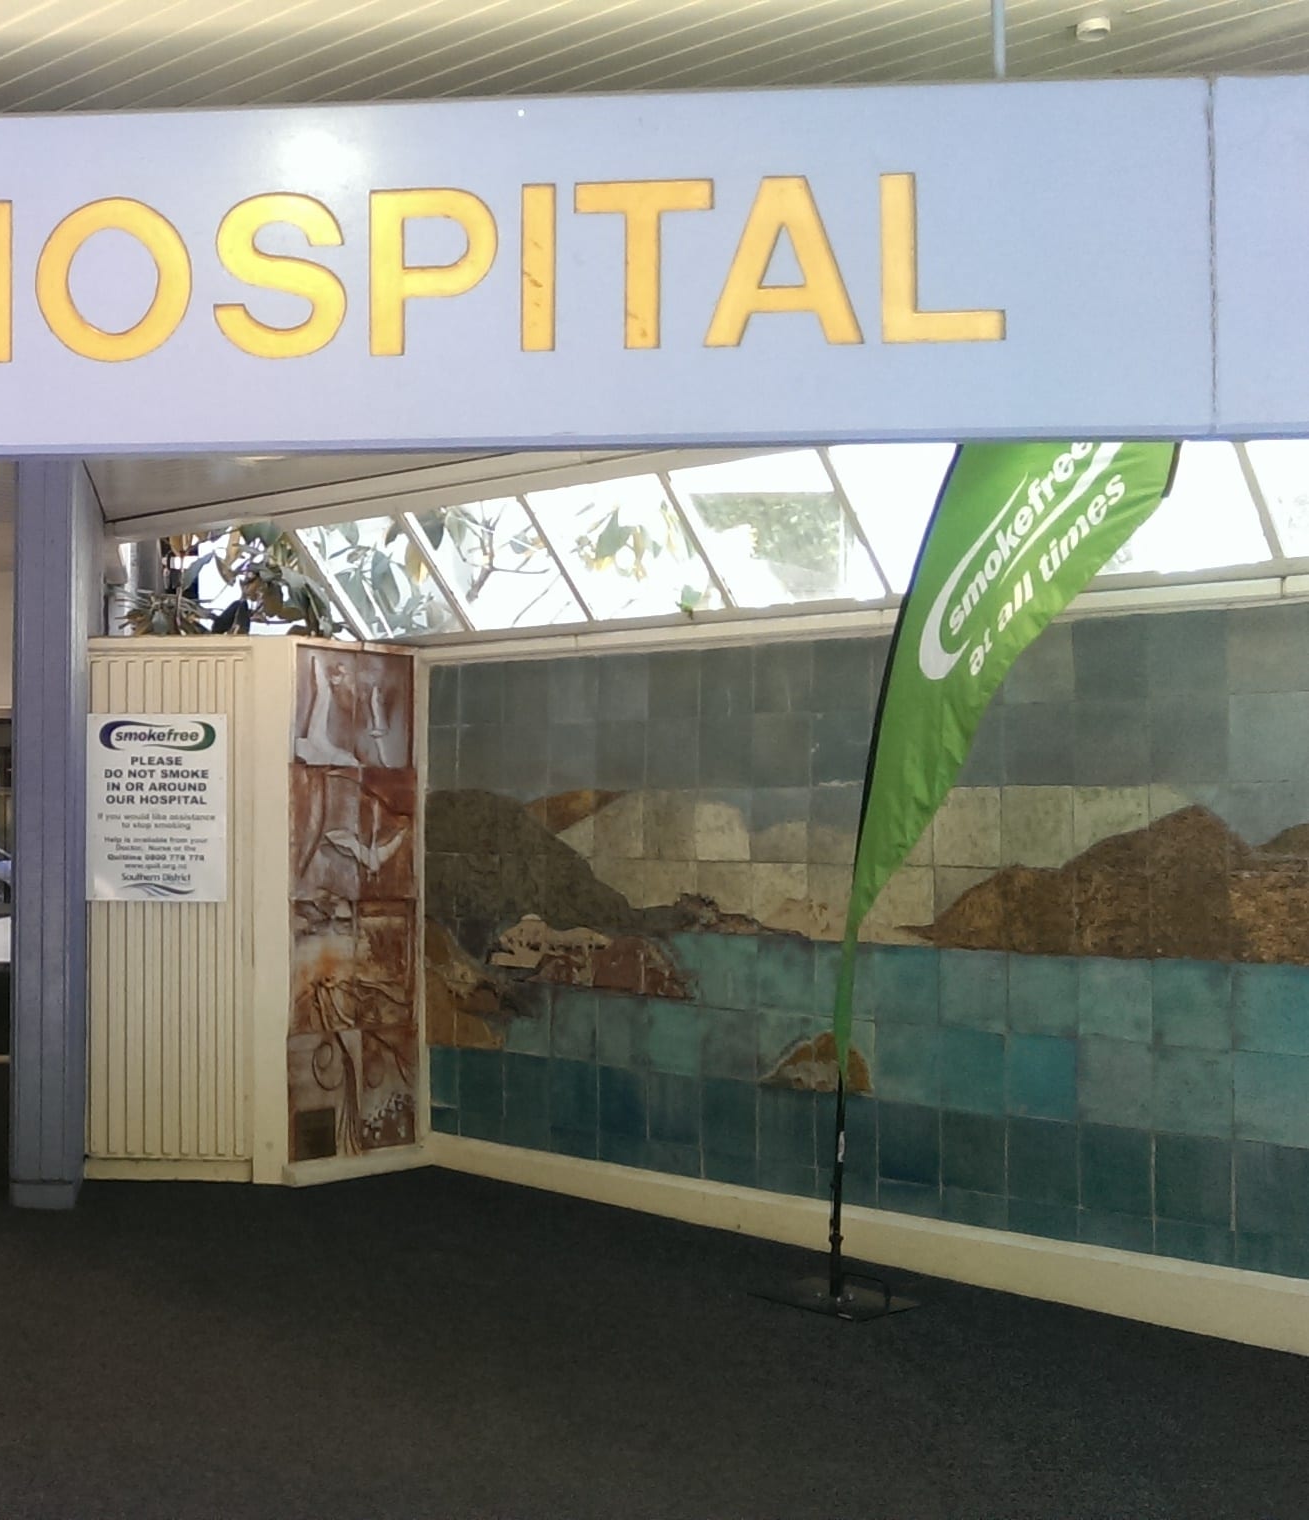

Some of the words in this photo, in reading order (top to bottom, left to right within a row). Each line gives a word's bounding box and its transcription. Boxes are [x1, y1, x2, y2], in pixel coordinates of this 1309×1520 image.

[969, 628, 994, 677] at
[996, 570, 1035, 633] all
[1038, 473, 1126, 583] times
[114, 728, 200, 742] smokefree
[130, 756, 184, 766] PLEASE
[104, 769, 124, 779] DO
[127, 769, 156, 779] NOT
[161, 769, 209, 779] SMOKE
[106, 782, 121, 792] IN
[125, 782, 145, 792] OR
[148, 782, 208, 792] AROUND
[105, 795, 136, 805] OUR
[139, 795, 208, 805] HOSPITAL
[121, 873, 161, 881] Southern
[162, 873, 191, 881] District
